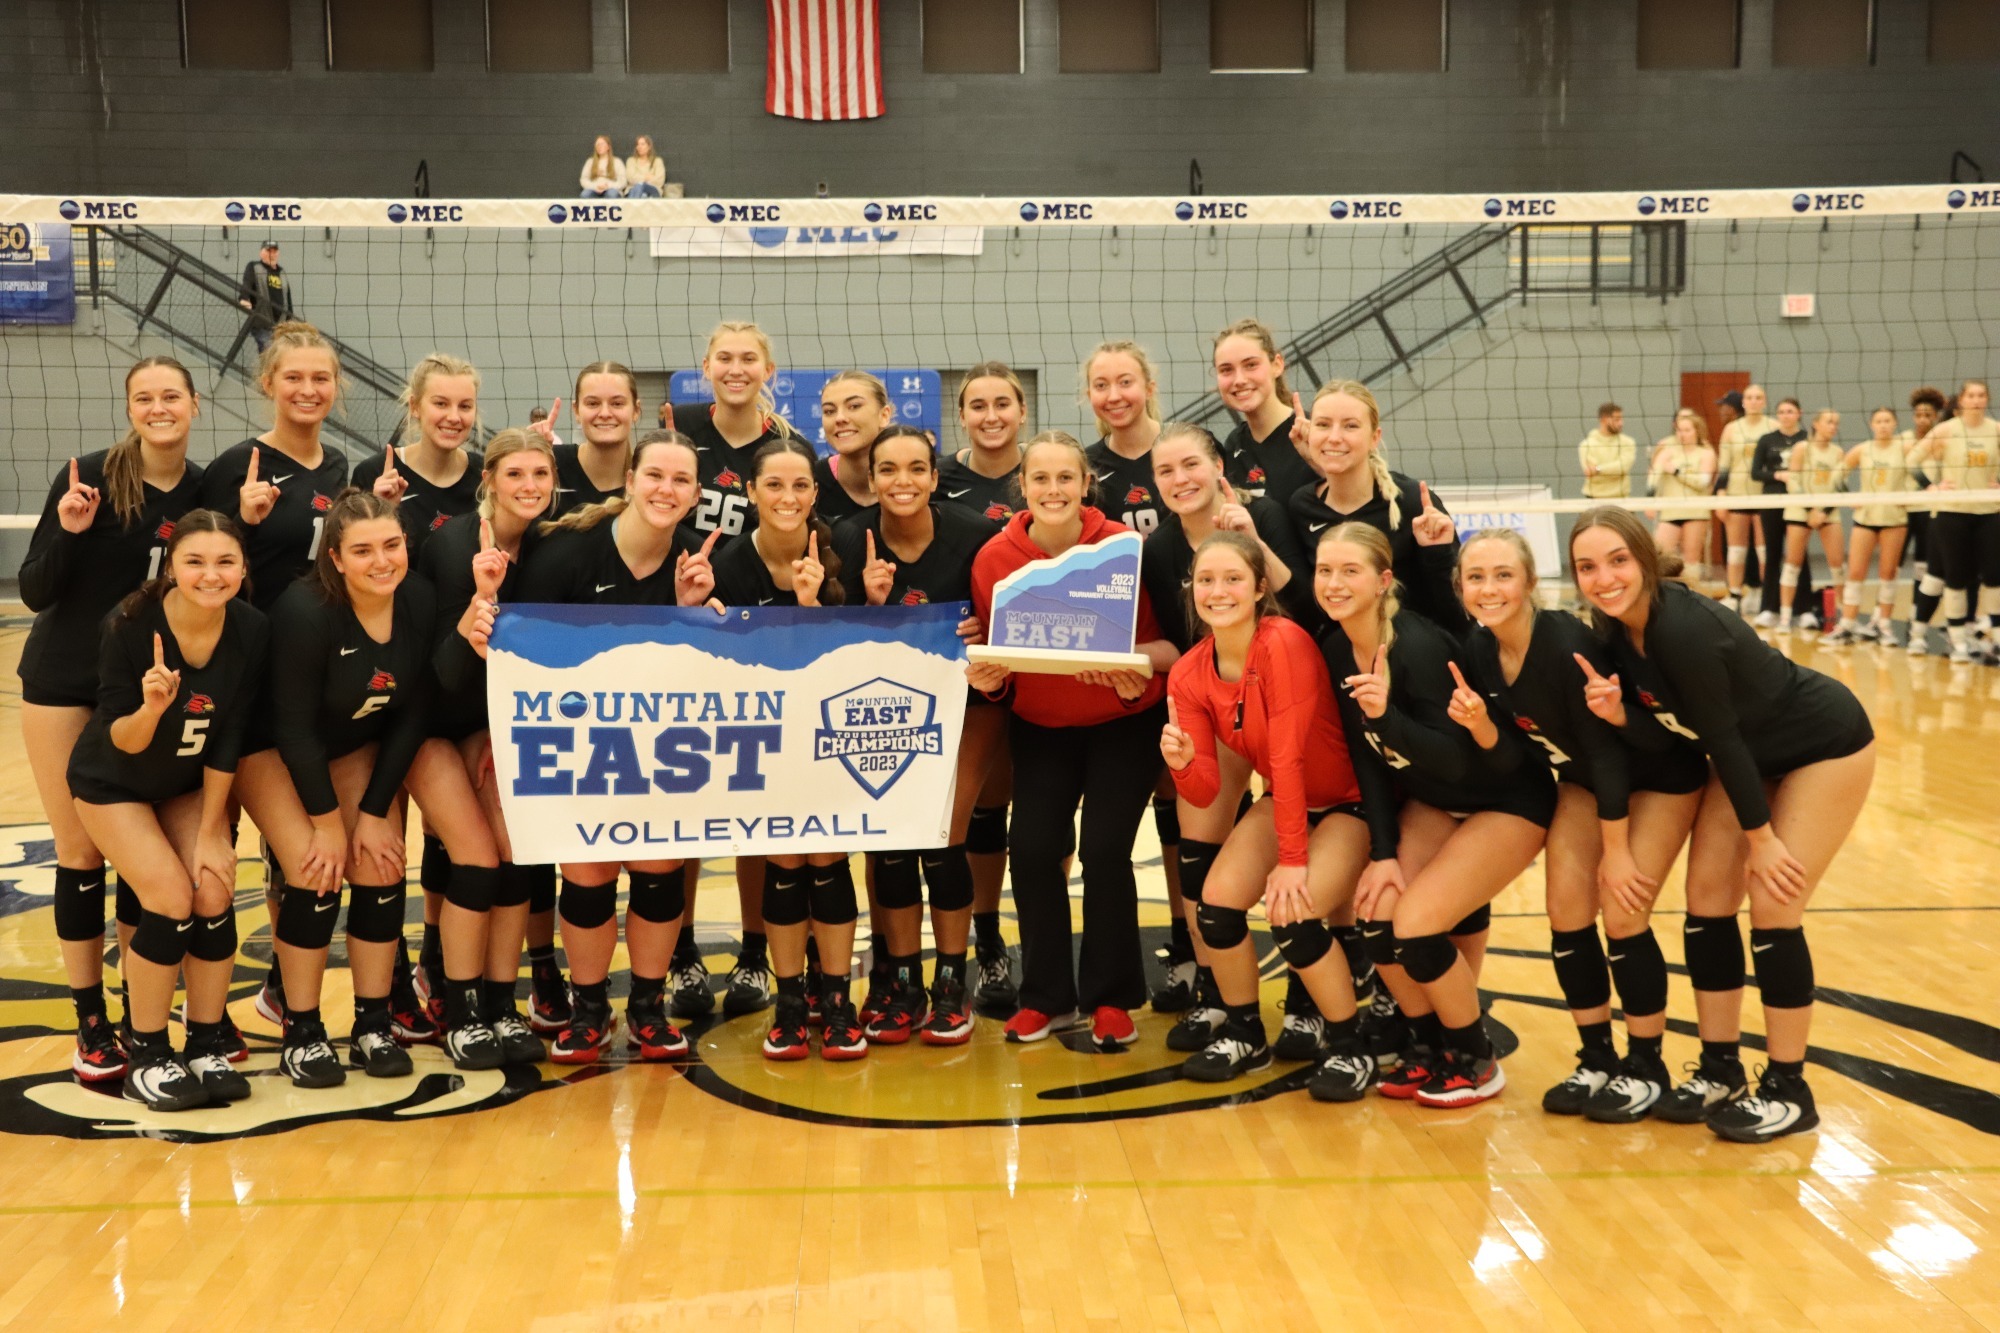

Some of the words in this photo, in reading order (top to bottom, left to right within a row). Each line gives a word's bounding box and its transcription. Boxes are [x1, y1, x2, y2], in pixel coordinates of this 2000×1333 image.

[1506, 199, 1556, 216] MEC
[1660, 197, 1709, 213] MEC
[1814, 194, 1865, 211] MEC
[1970, 191, 2000, 207] ME
[84, 202, 138, 220] MEC
[249, 204, 302, 221] MEC
[410, 205, 463, 222] MEC
[570, 205, 623, 222] MEC
[729, 205, 780, 222] MEC
[886, 204, 937, 221] MEC
[1042, 203, 1093, 220] MEC
[1197, 202, 1248, 219] MEC
[1352, 201, 1402, 218] MEC
[695, 489, 748, 536] 26
[1454, 512, 1524, 527] TAIN
[1111, 573, 1135, 586] 2023
[1068, 591, 1104, 599] TOURNAMENT
[1104, 593, 1133, 601] CHAMPION
[1096, 584, 1133, 594] VOLLEYBALL
[1006, 610, 1098, 627] MOUNTAIN
[1004, 623, 1096, 649] EAST
[512, 690, 785, 722] MOUNTAIN
[845, 696, 912, 707] MOUNTAIN
[844, 705, 911, 726] EAST
[177, 719, 210, 757] 5
[835, 727, 919, 739] TOURNAMENT
[818, 731, 939, 758] CHAMPIONS
[511, 724, 783, 797] EAST
[859, 755, 898, 772] 2023
[576, 813, 888, 846] VOLLEYBALL
